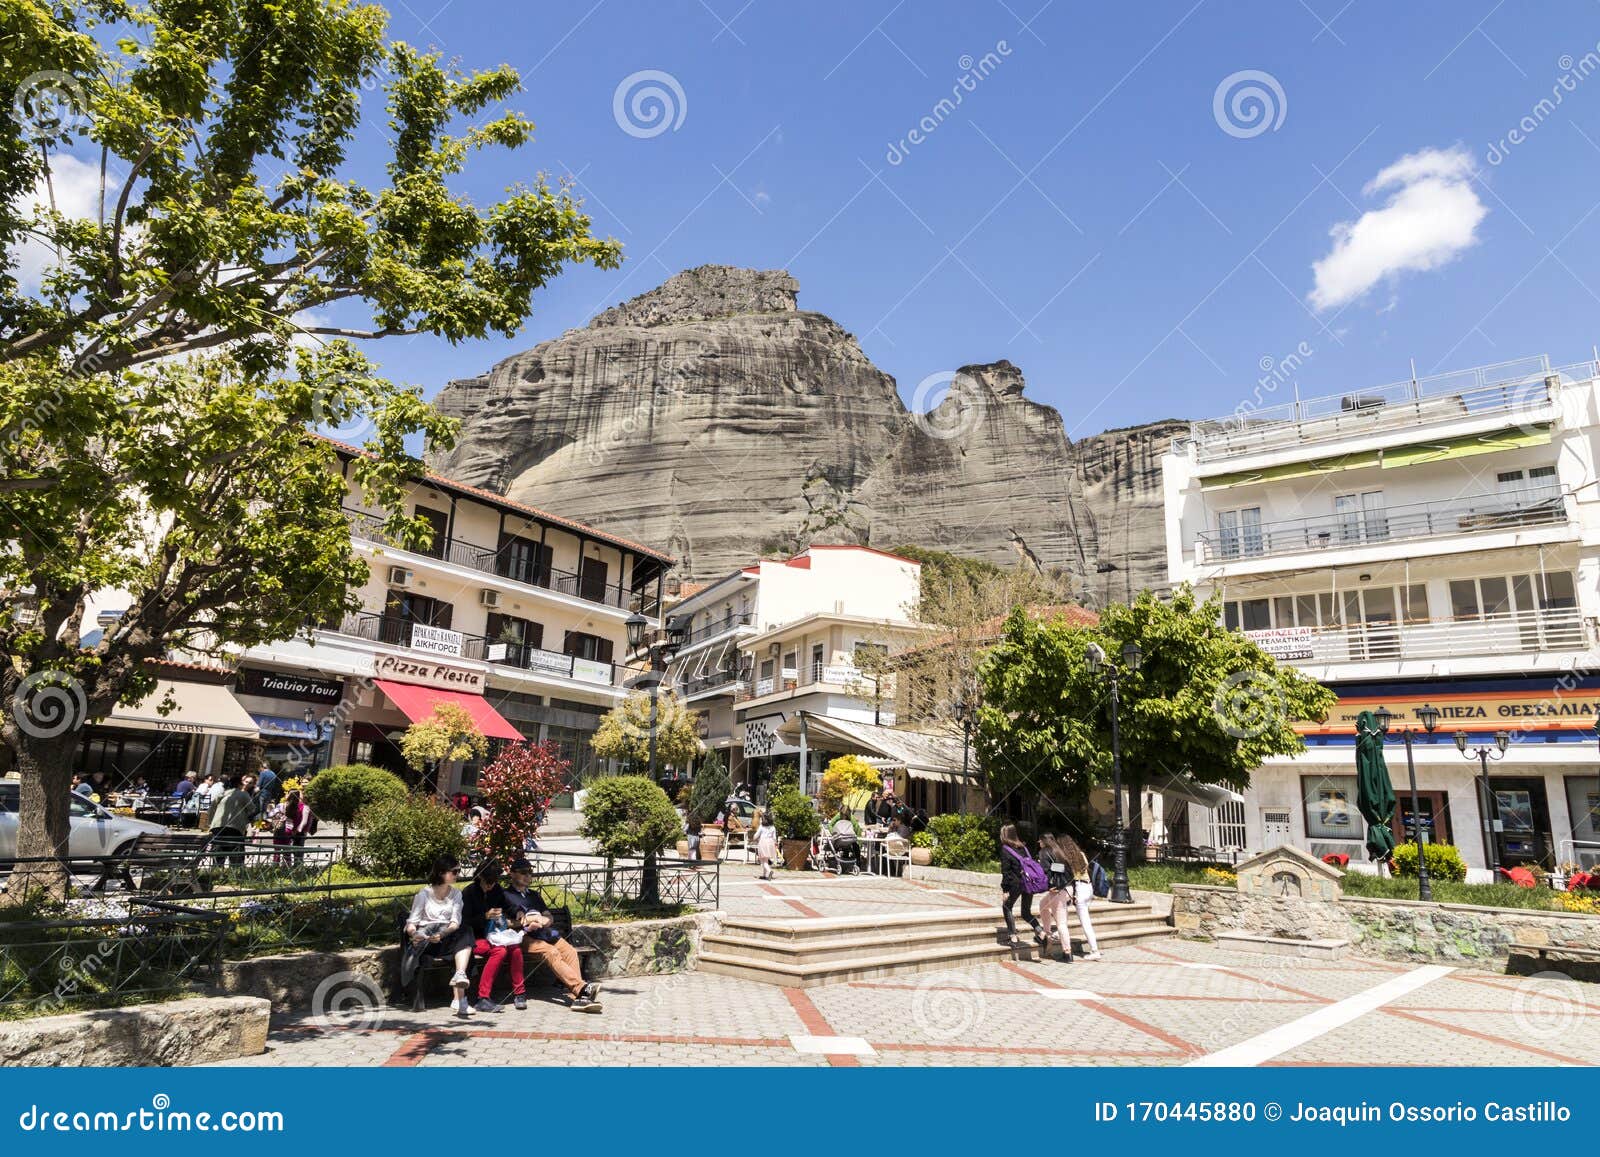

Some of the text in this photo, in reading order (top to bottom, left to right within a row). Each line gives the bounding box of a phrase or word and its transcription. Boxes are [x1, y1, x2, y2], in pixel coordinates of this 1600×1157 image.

[415, 639, 458, 654] ΔΙΚΗΓΟΡΟΣ
[382, 657, 479, 685] Pizza Fiesta
[262, 677, 308, 692] Tsiatsios
[311, 684, 338, 696] Tours
[155, 721, 204, 733] TAVERN
